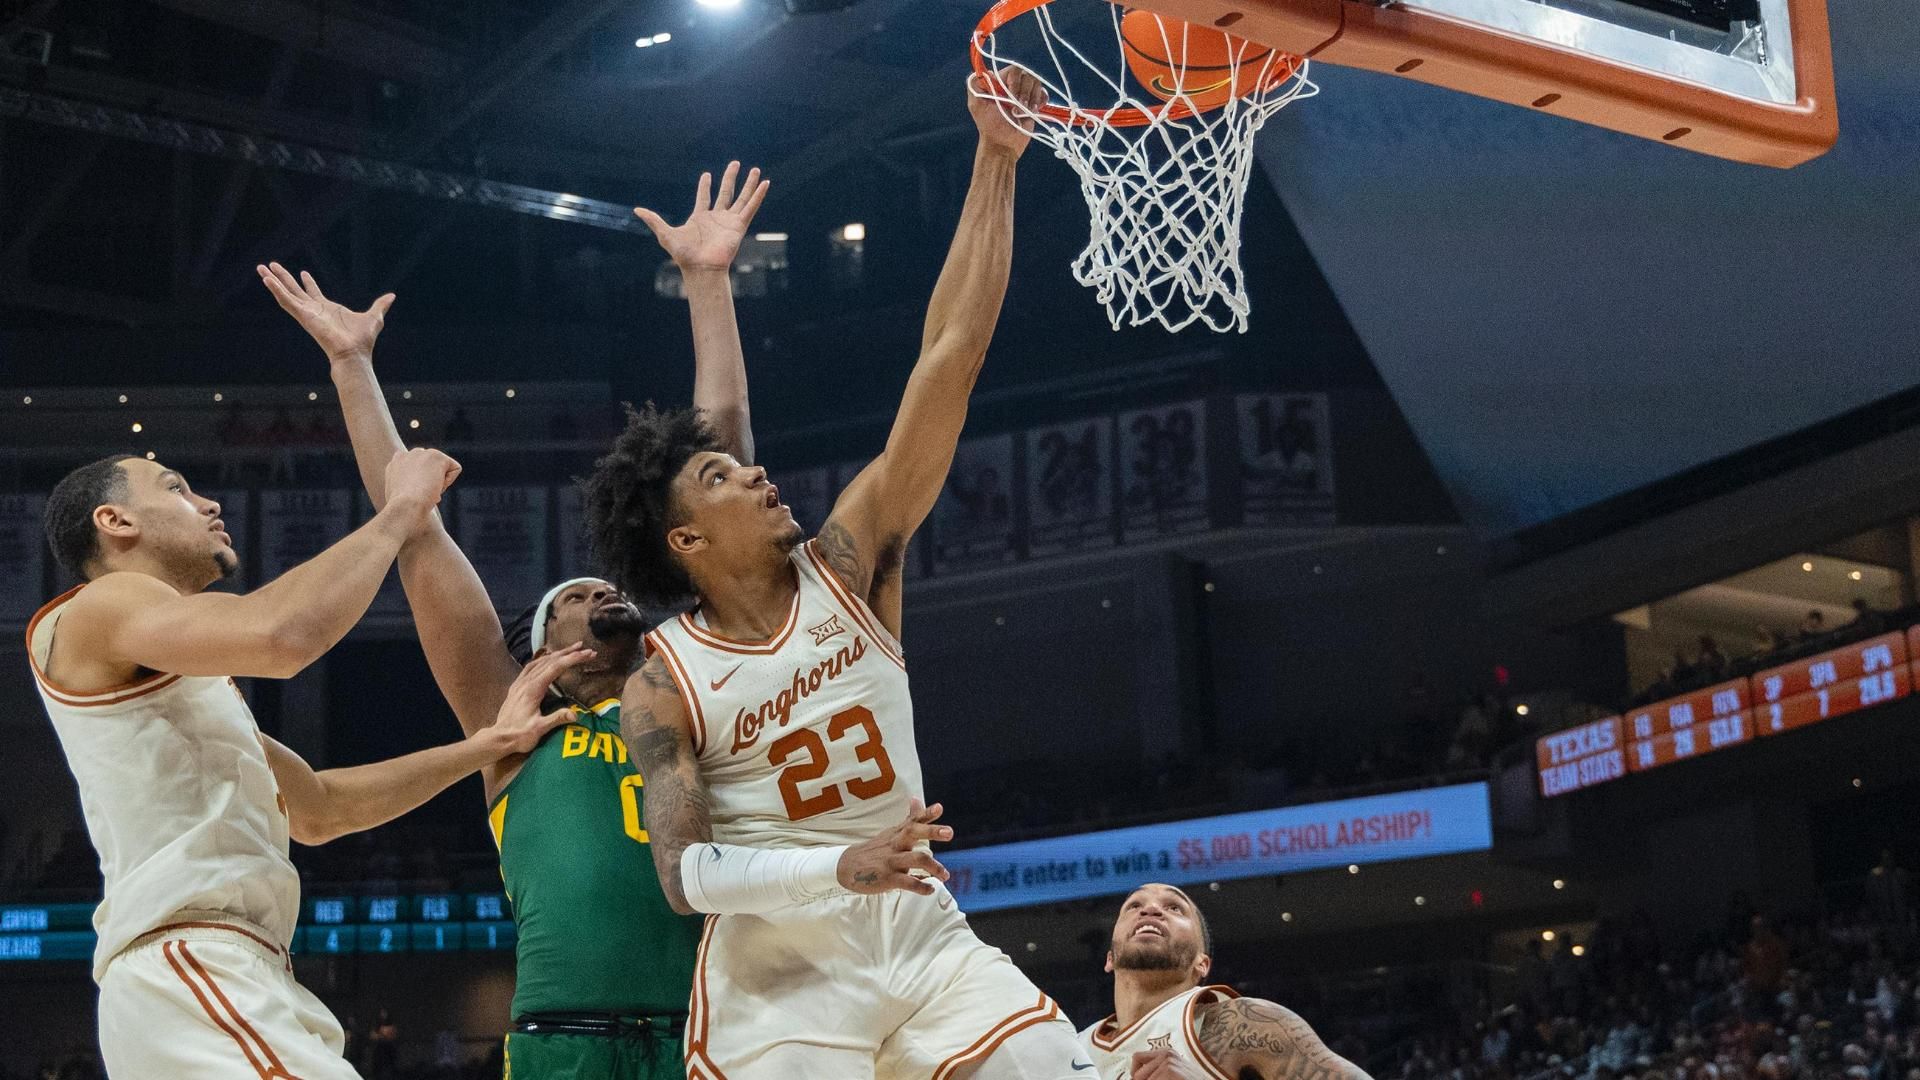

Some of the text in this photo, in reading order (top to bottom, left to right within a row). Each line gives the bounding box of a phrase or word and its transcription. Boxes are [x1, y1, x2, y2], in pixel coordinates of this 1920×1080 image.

[730, 635, 867, 756] Longhorns
[1770, 702, 1784, 731] 2
[768, 705, 896, 821] 23
[1546, 719, 1616, 764] TEXAS
[1540, 750, 1624, 798] TEAM STATS
[979, 863, 1017, 893] and
[1022, 860, 1078, 887] enter
[1085, 855, 1105, 880] to
[1112, 846, 1150, 876] win
[1157, 850, 1169, 872] a
[1177, 832, 1250, 870] $5,000
[1257, 809, 1433, 857] SCHOLARSHIP!
[326, 929, 339, 952] 4
[379, 926, 393, 951] 2
